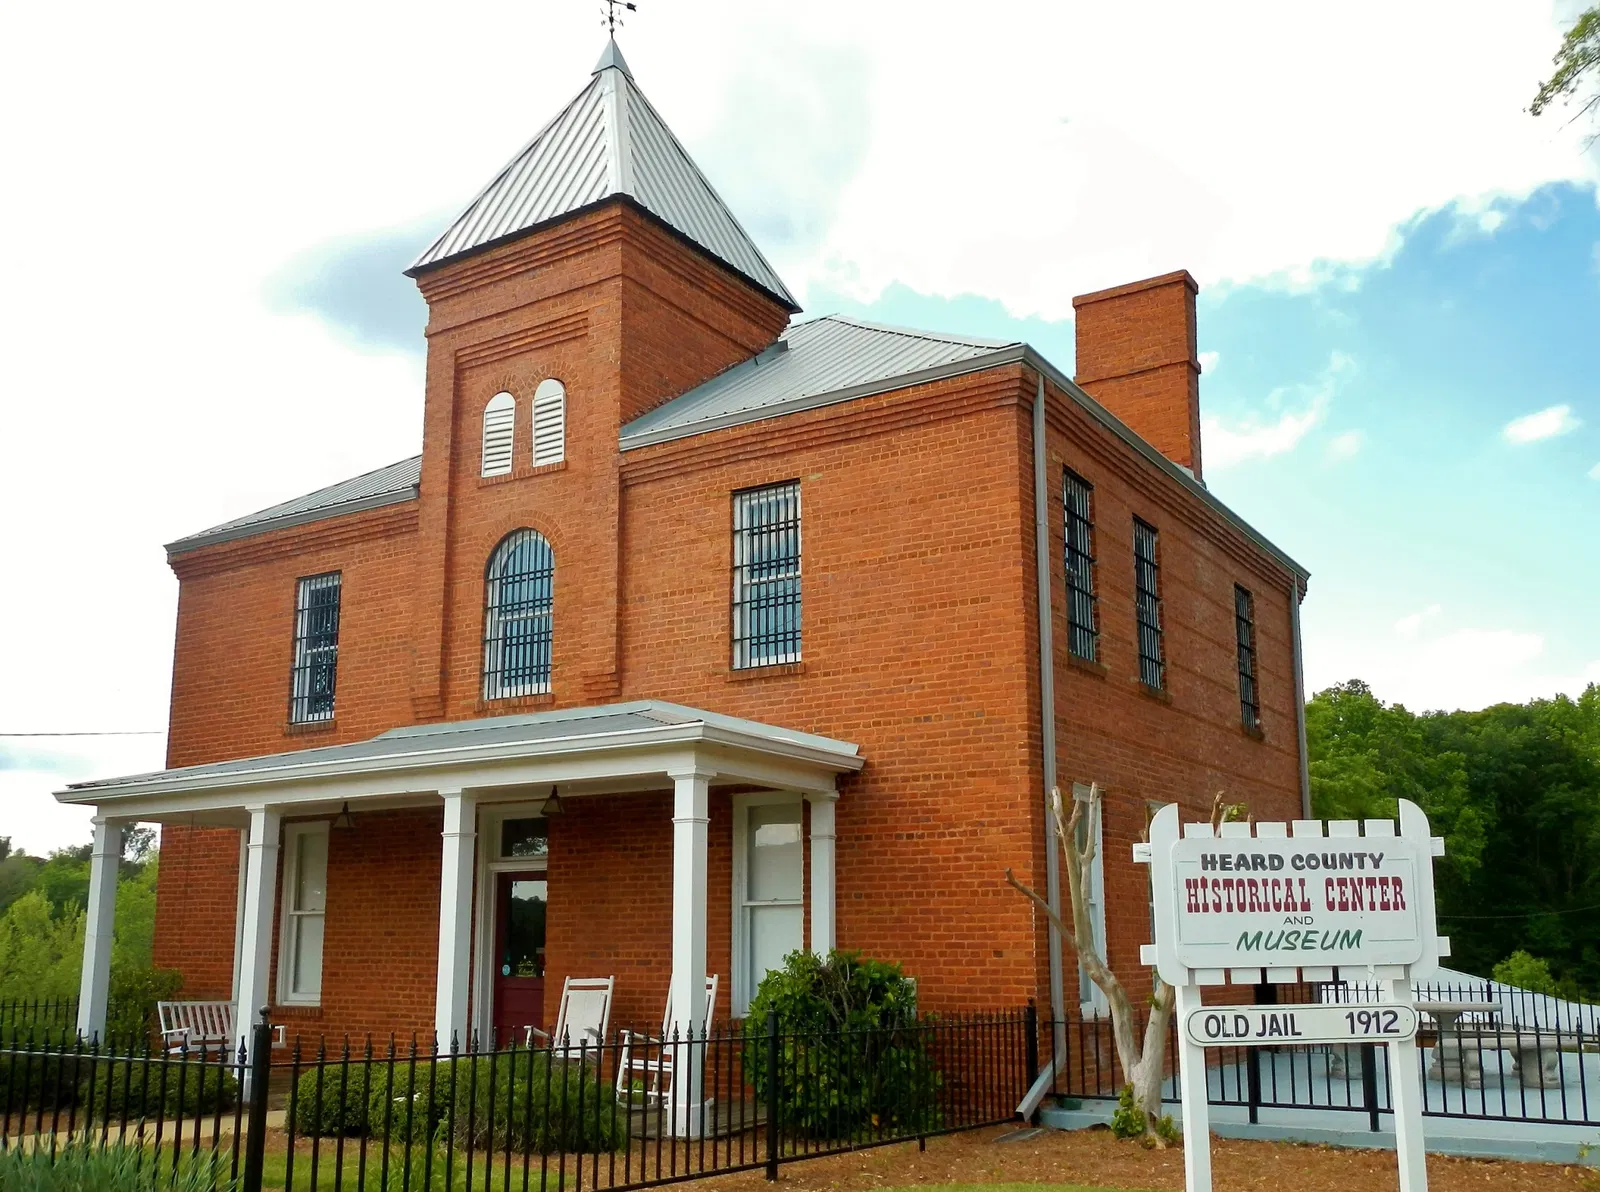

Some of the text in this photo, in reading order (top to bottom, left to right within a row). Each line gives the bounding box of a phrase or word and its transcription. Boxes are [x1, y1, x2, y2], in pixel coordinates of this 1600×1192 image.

[1201, 852, 1384, 872] HEARD COUNTY
[1186, 876, 1406, 913] HISTORICAL CENTER
[1283, 916, 1314, 926] AND
[1236, 929, 1362, 951] MUSEUM
[1204, 1010, 1400, 1038] OLD JAIL 1912
